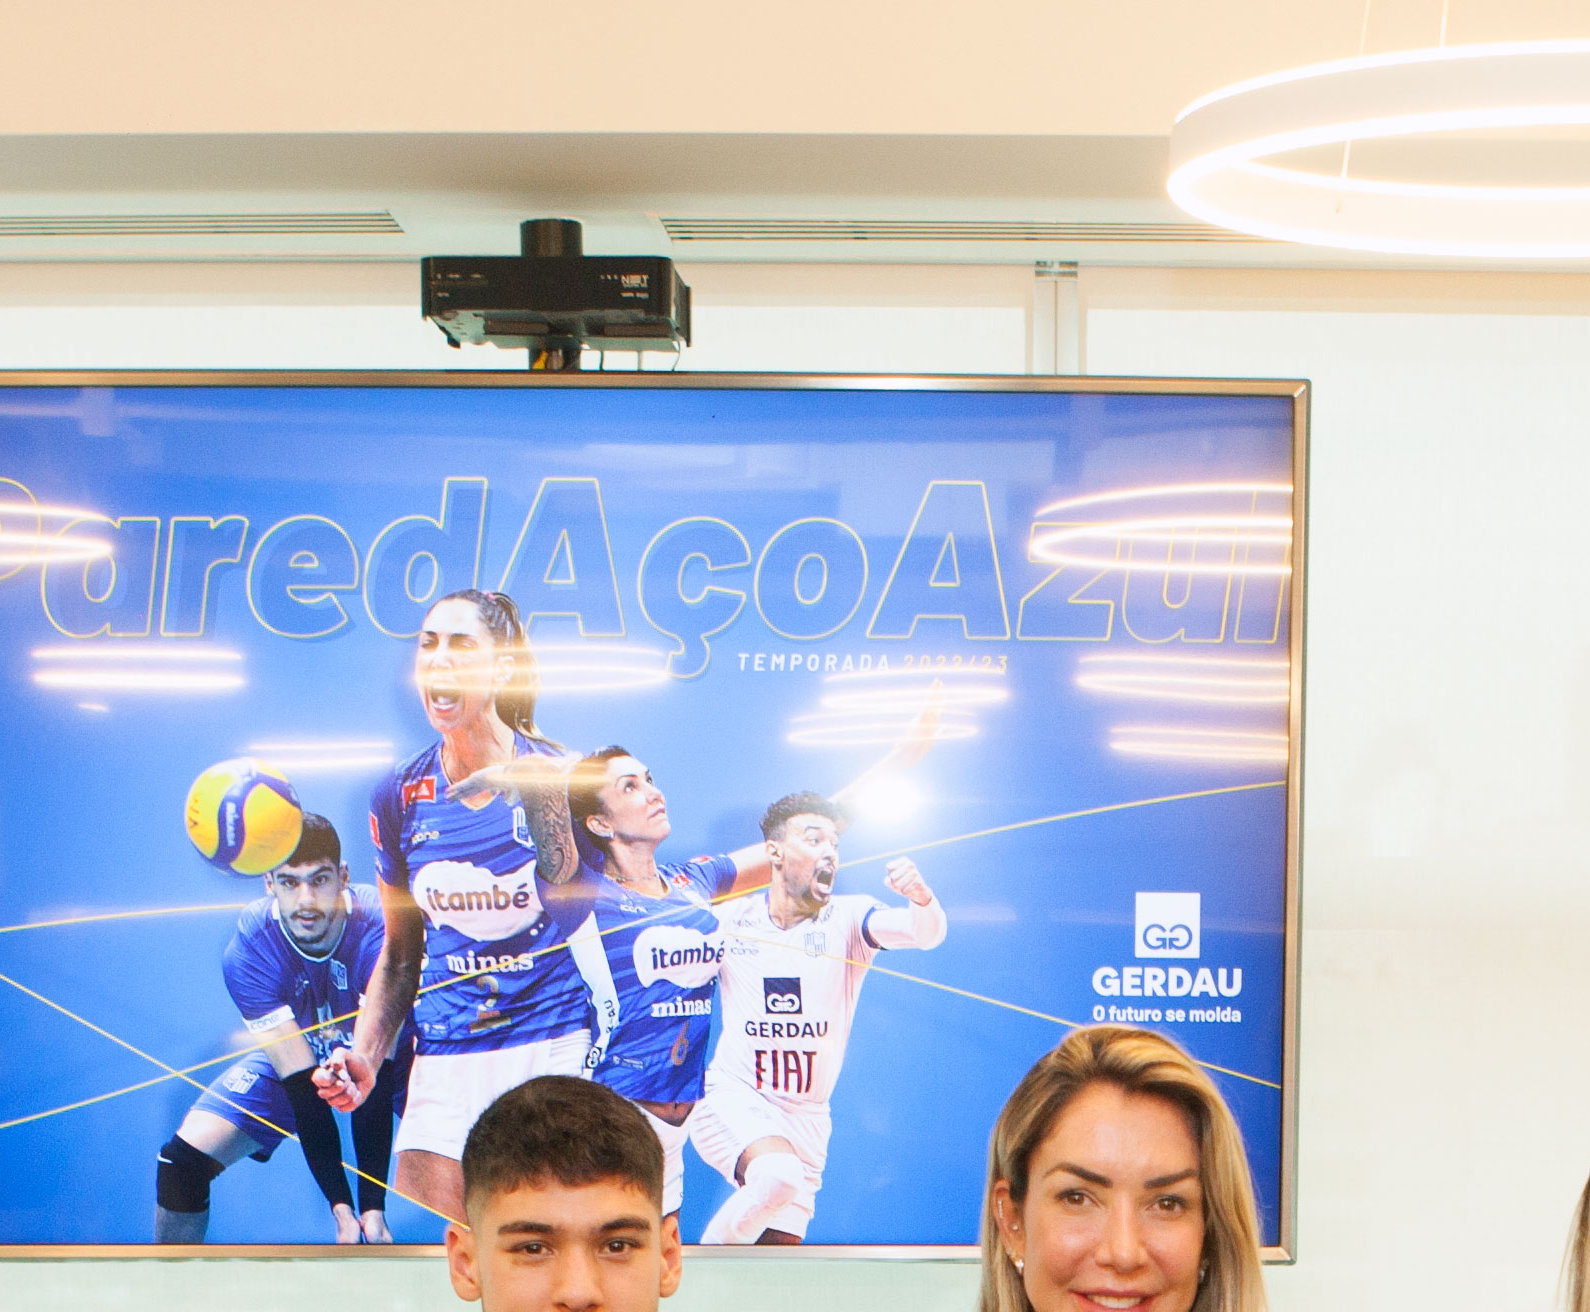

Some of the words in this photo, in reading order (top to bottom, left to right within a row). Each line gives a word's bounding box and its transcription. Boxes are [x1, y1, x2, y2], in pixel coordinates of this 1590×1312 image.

[738, 652, 891, 674] TEMPORADA
[425, 882, 531, 912] itambé
[445, 950, 534, 975] minas
[650, 940, 726, 971] itambé
[1092, 966, 1243, 998] GERDAU
[651, 996, 712, 1018] minas
[1093, 1005, 1106, 1022] O
[1108, 1004, 1162, 1022] futuro
[1165, 1009, 1186, 1022] se
[1189, 1005, 1242, 1023] molda
[671, 1019, 690, 1067] 6
[745, 1020, 829, 1039] GERDAU
[755, 1050, 818, 1094] FIAT
